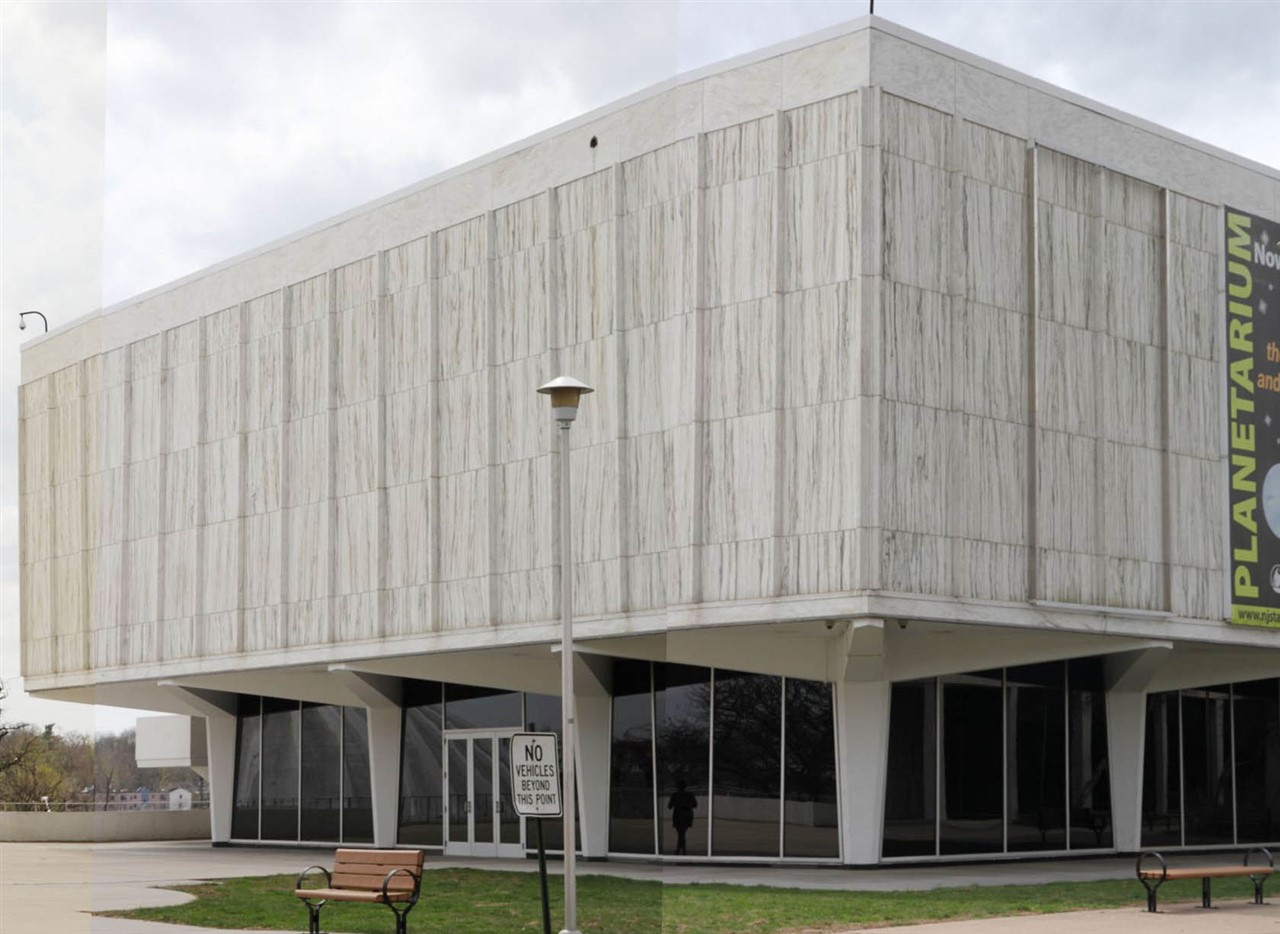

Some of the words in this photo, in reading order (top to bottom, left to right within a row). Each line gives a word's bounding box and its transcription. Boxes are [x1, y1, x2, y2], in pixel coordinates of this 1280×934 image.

[1227, 212, 1259, 598] PLANETARIUM
[524, 744, 543, 762] NO
[515, 764, 555, 778] VEHICLES
[521, 780, 551, 792] BEYOND
[517, 793, 534, 806] THIS
[535, 793, 557, 806] POINT
